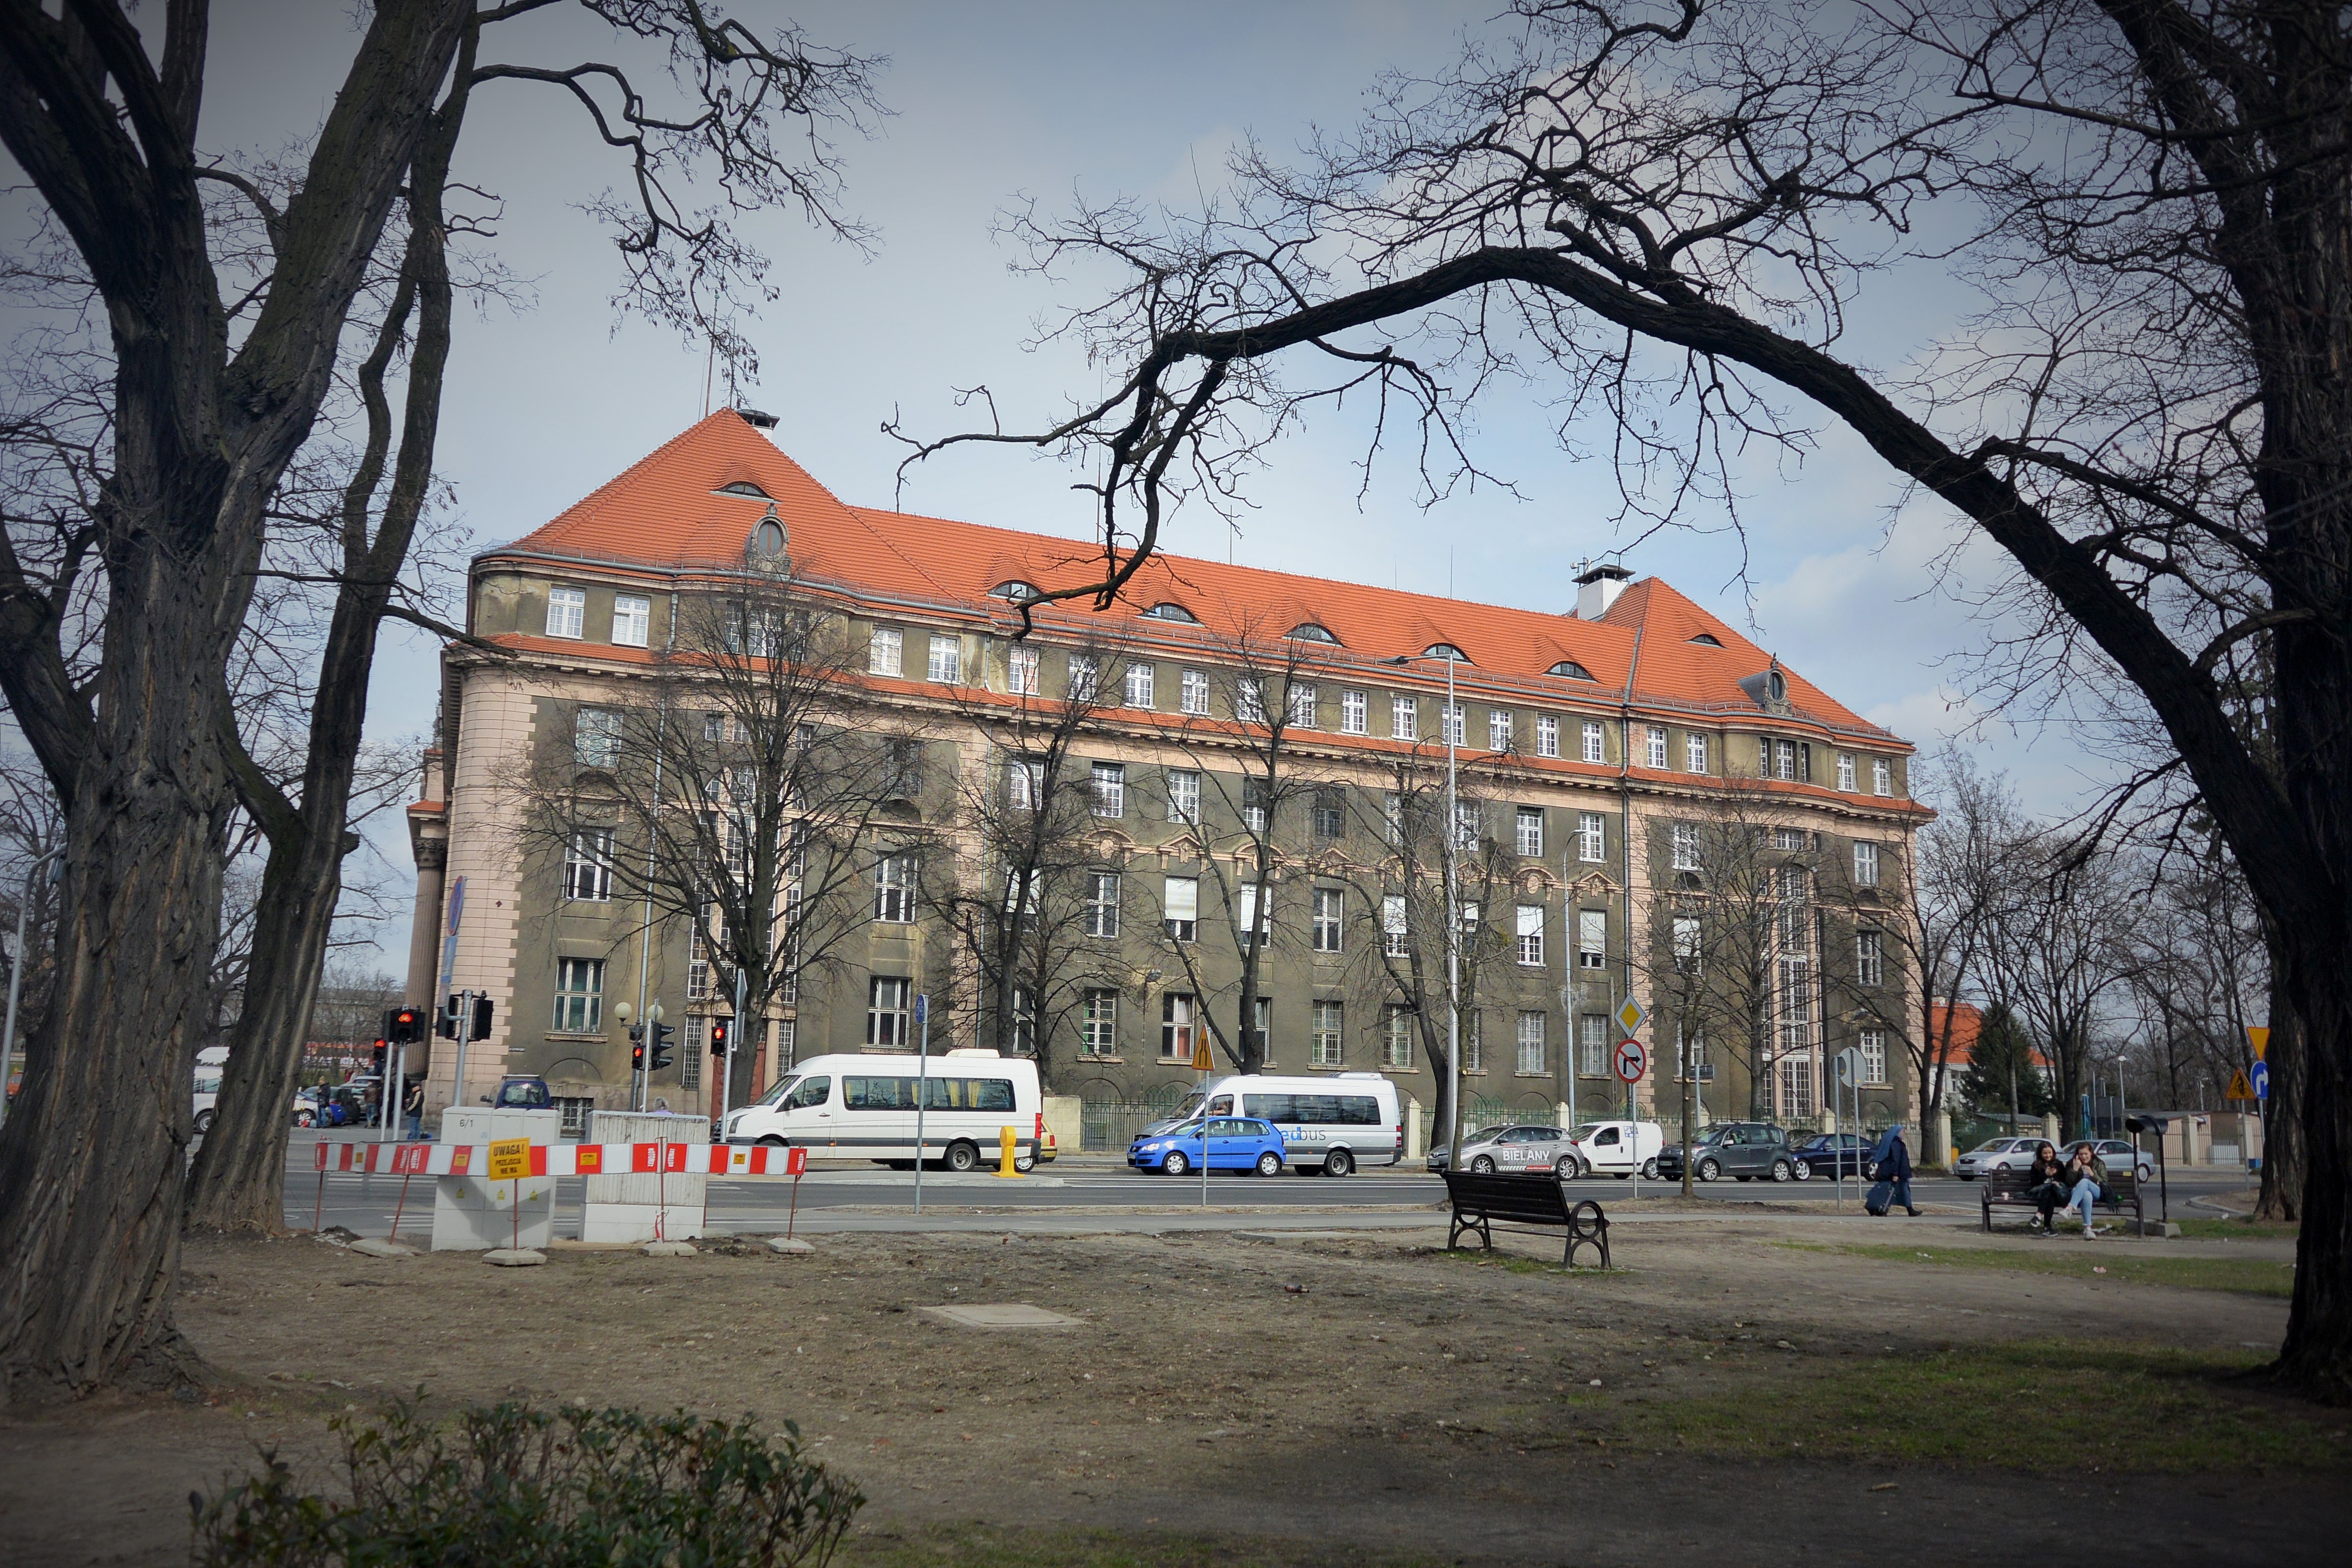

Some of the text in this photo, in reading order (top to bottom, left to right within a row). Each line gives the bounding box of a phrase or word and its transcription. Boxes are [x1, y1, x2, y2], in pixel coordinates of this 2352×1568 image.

[460, 1119, 473, 1129] 6/1
[1280, 1126, 1326, 1141] edbus
[1503, 1150, 1550, 1161] BIELANY
